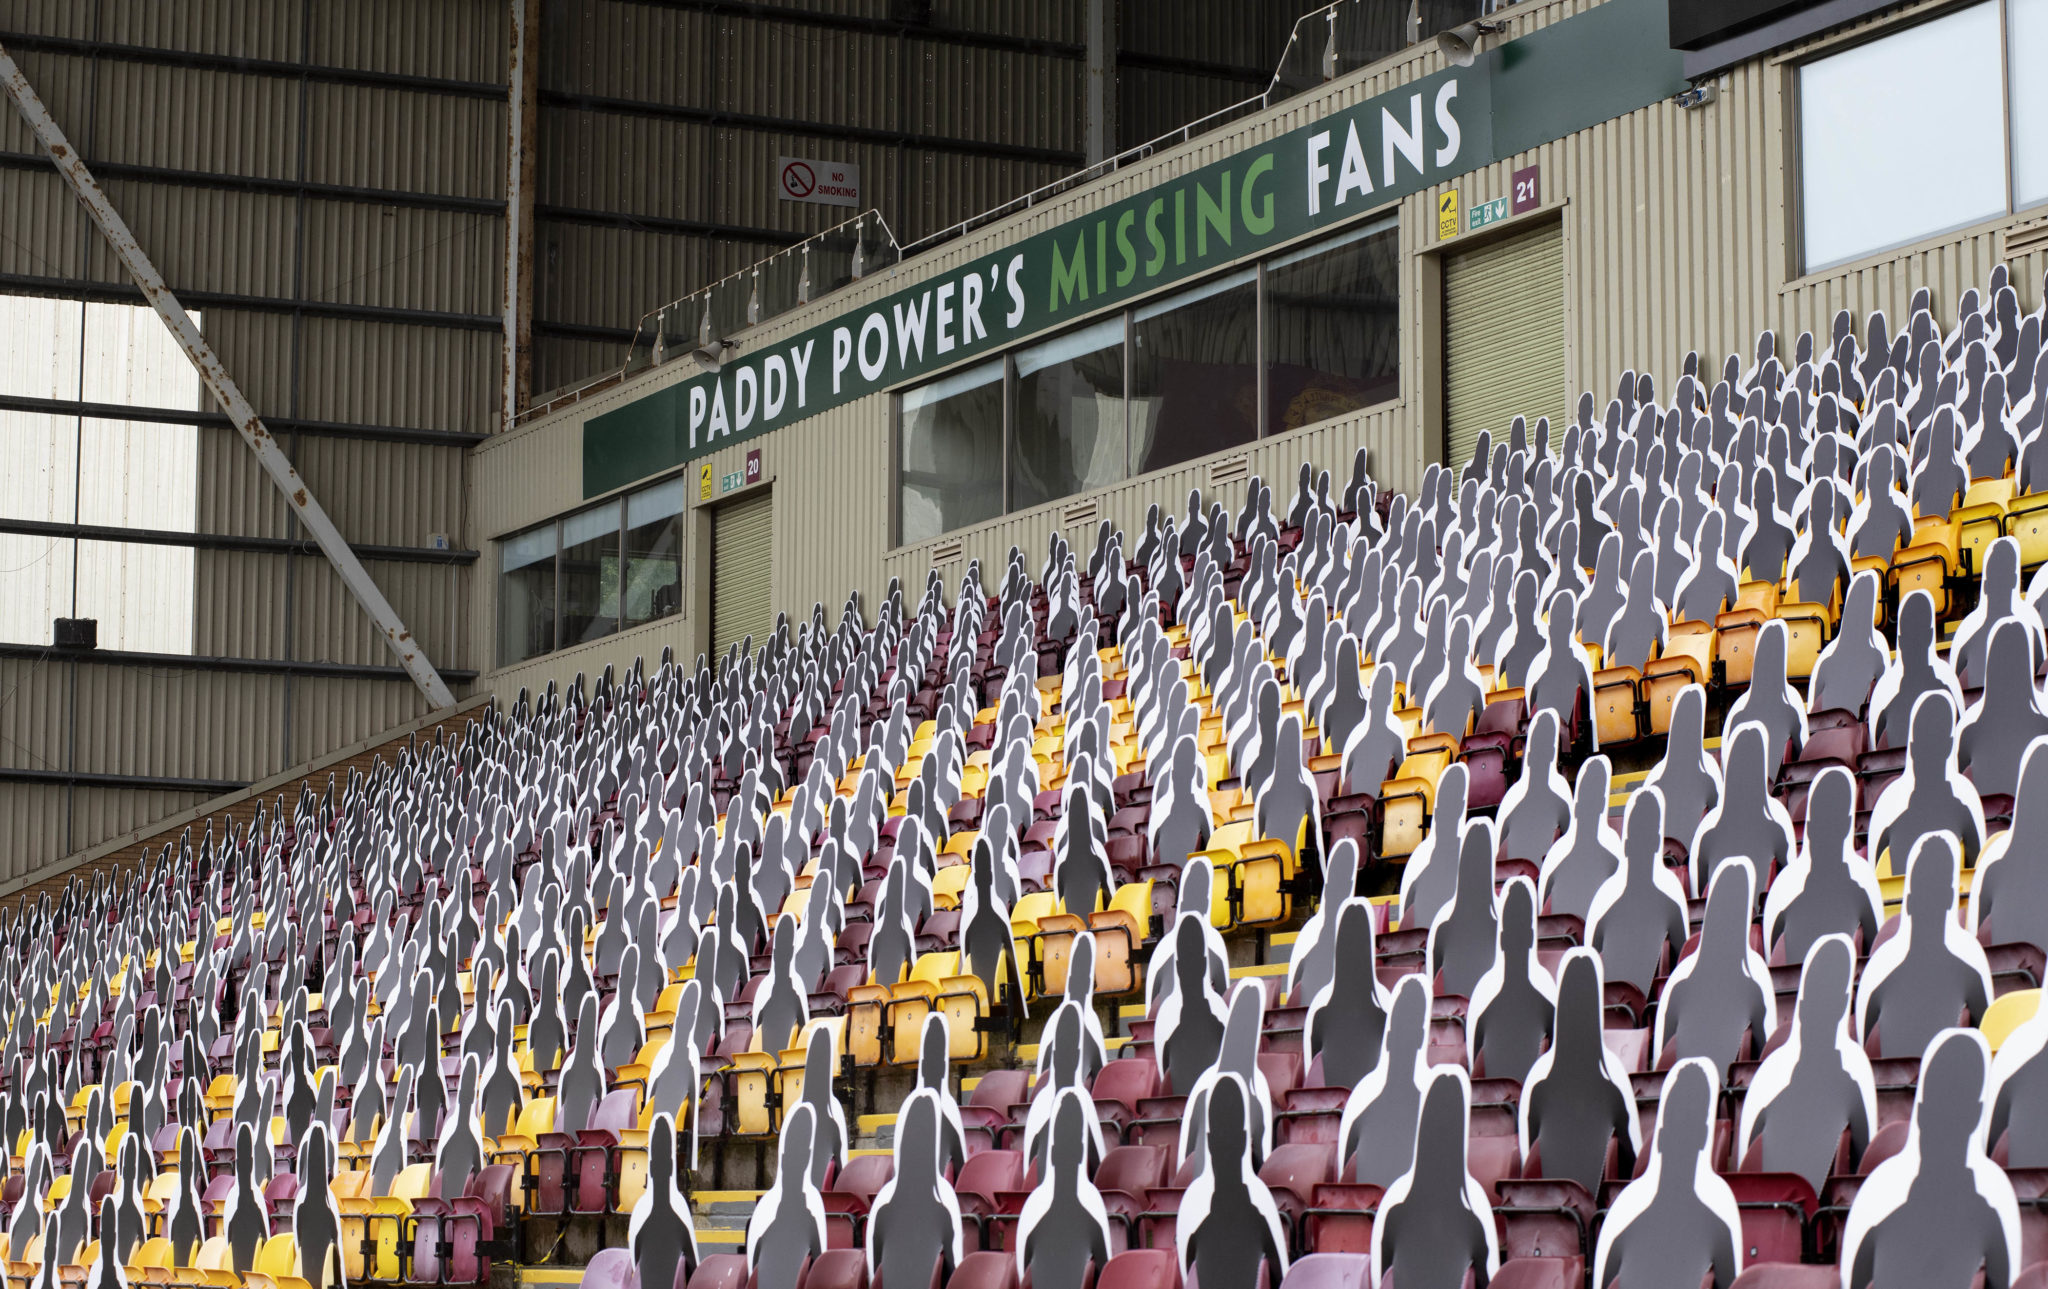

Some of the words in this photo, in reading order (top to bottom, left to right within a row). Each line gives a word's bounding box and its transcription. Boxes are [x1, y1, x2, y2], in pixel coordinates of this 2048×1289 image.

[832, 172, 844, 182] NO
[818, 184, 857, 198] SMOKING
[1516, 177, 1535, 204] 21
[1440, 218, 1456, 229] CCTV
[689, 339, 815, 449] PADDY
[832, 253, 1026, 395] POWER'S
[1049, 152, 1275, 313] MISSING
[1307, 79, 1461, 217] FANS
[748, 458, 759, 476] 20
